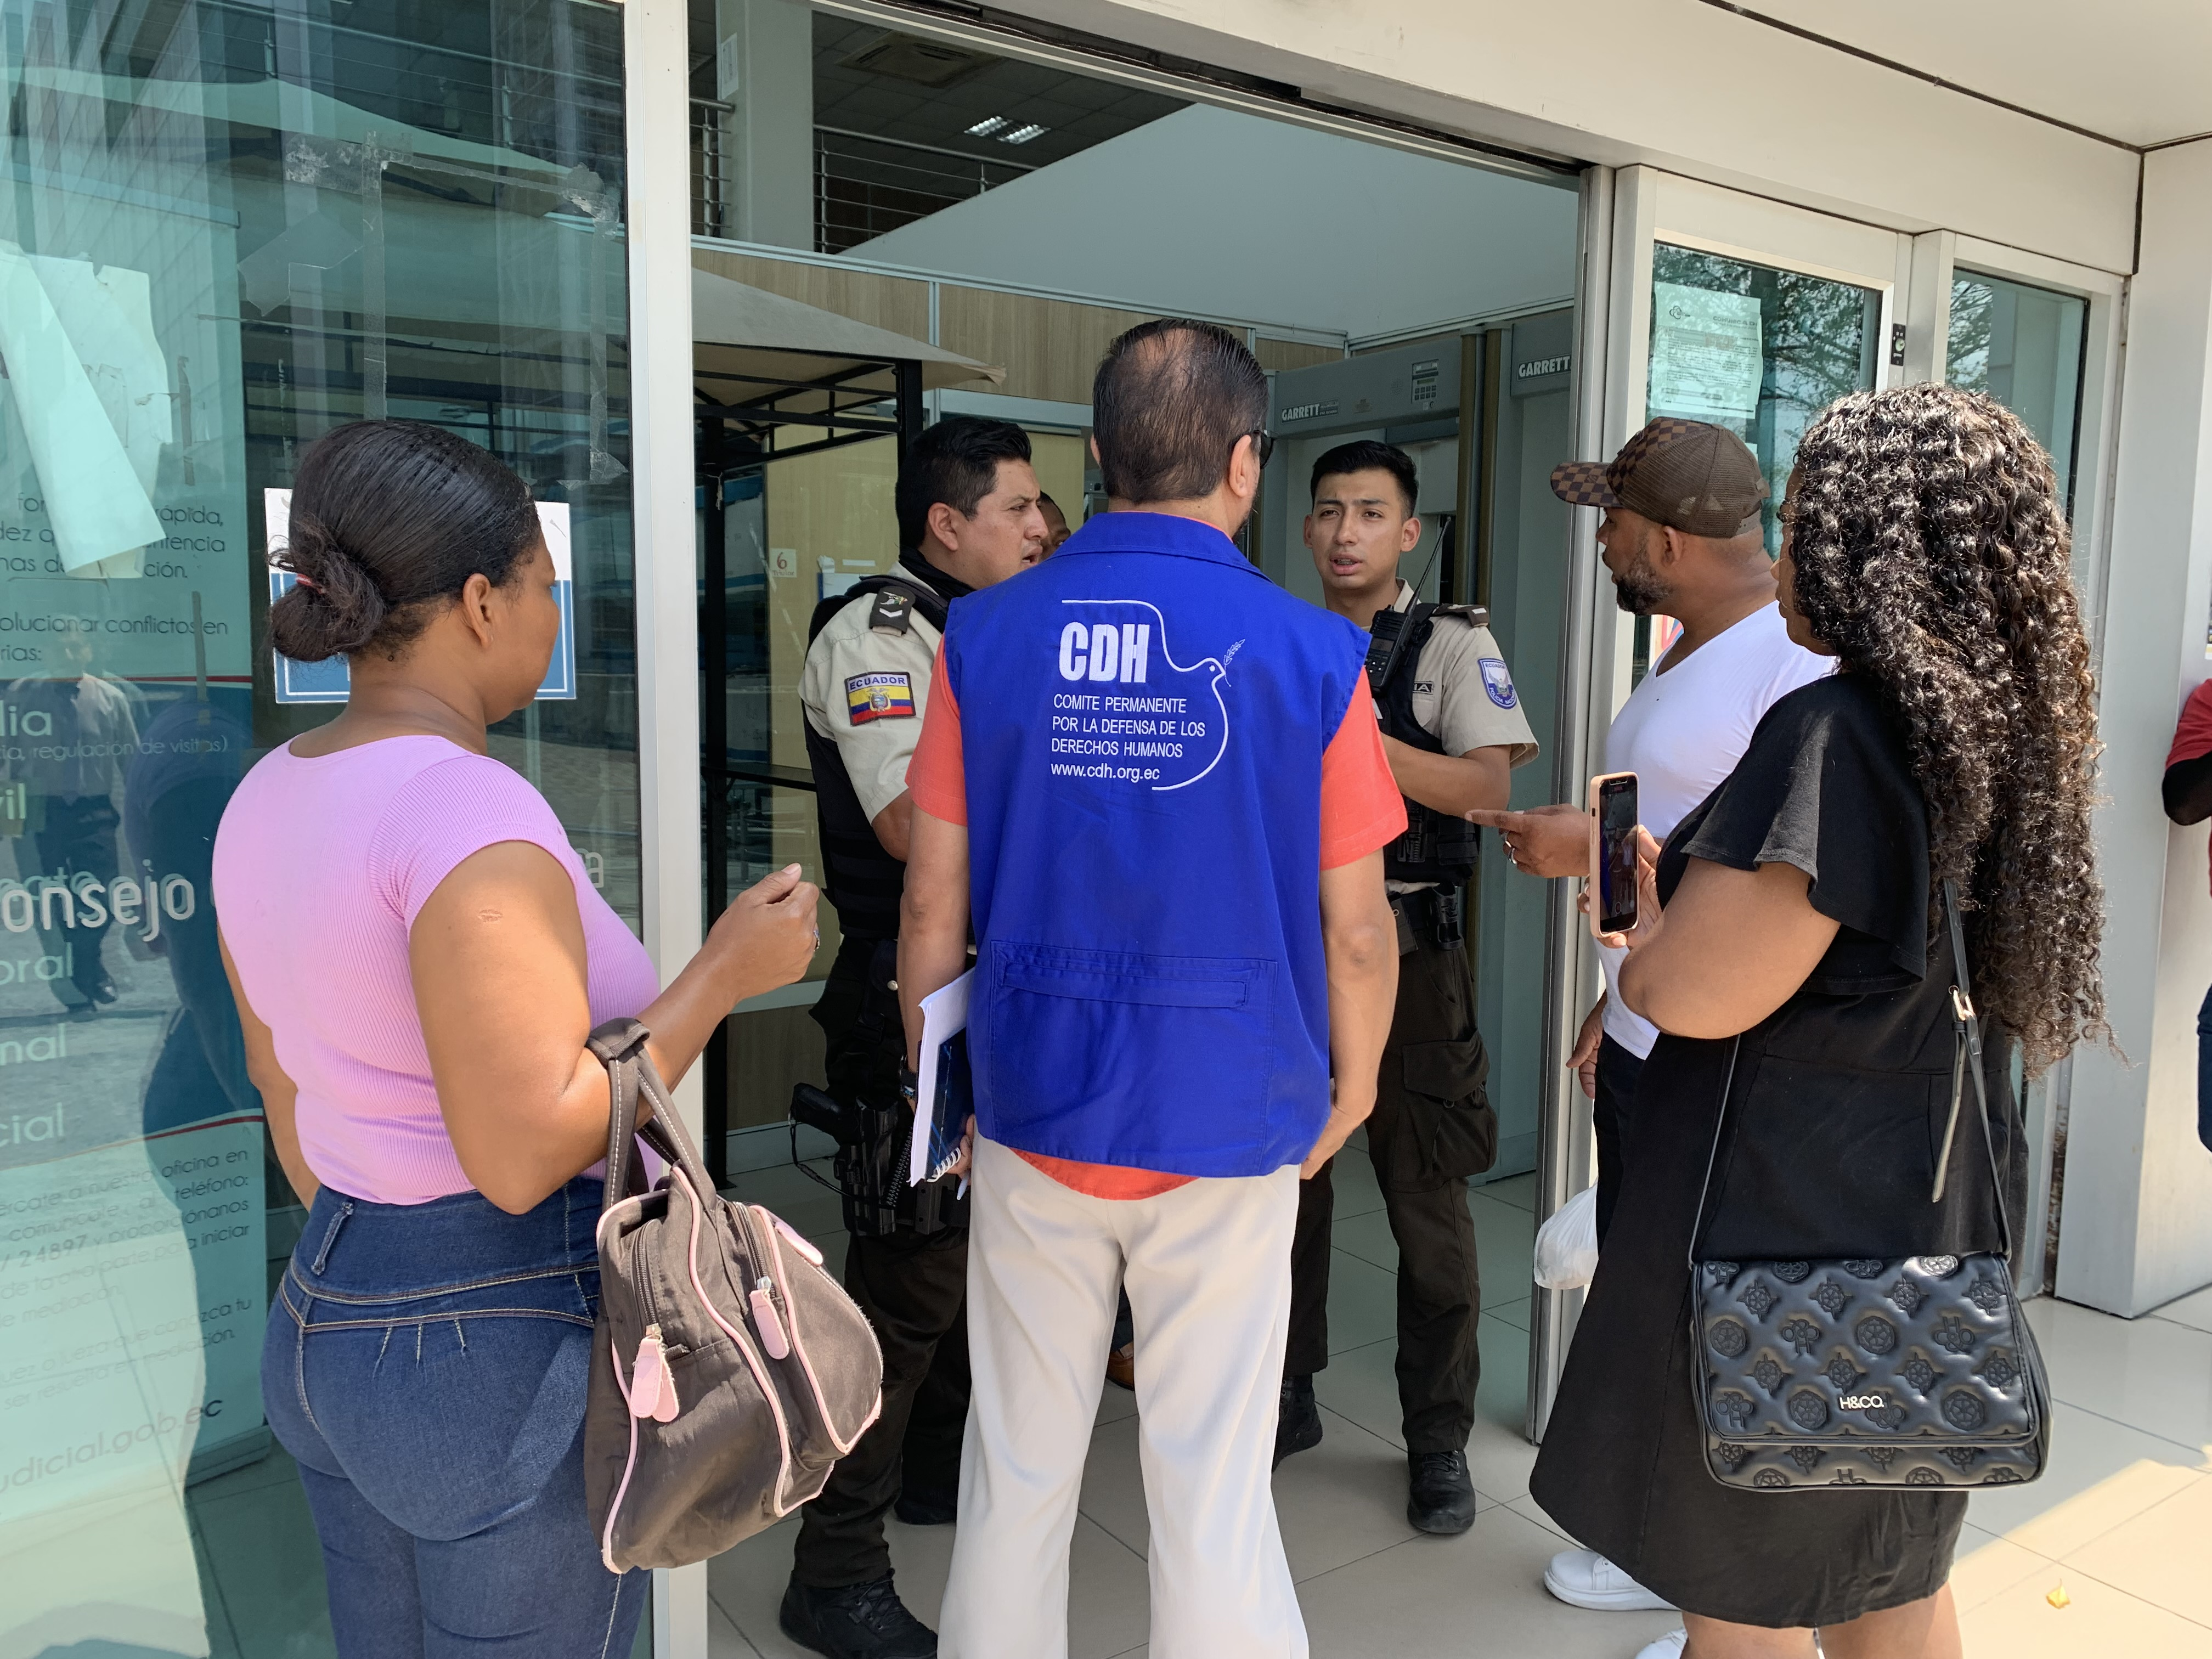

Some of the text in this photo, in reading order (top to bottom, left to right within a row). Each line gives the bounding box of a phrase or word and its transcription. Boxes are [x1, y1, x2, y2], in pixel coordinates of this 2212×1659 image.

[1519, 356, 1570, 377] GARRETT
[1282, 404, 1319, 421] GARRETT
[777, 551, 787, 569] 6
[203, 620, 228, 635] en
[1059, 622, 1150, 683] CDH
[850, 676, 906, 690] ECUADOR
[1053, 694, 1187, 713] COMITE PERMANENTE
[1052, 716, 1205, 737] POR LA DEFENSA DE LOS
[33, 738, 134, 761] regulación
[139, 738, 165, 755] de
[1051, 738, 1183, 758] DERECHOS HUMANOS
[1051, 763, 1160, 783] www.cdh.org.ec
[161, 1155, 219, 1178] oficina
[225, 1149, 248, 1164] en
[201, 1224, 250, 1245] iniciar
[19, 1233, 88, 1268] 24897
[235, 1298, 252, 1311] tu
[4, 1392, 32, 1410] ser
[1839, 1395, 1884, 1409] H&CO.
